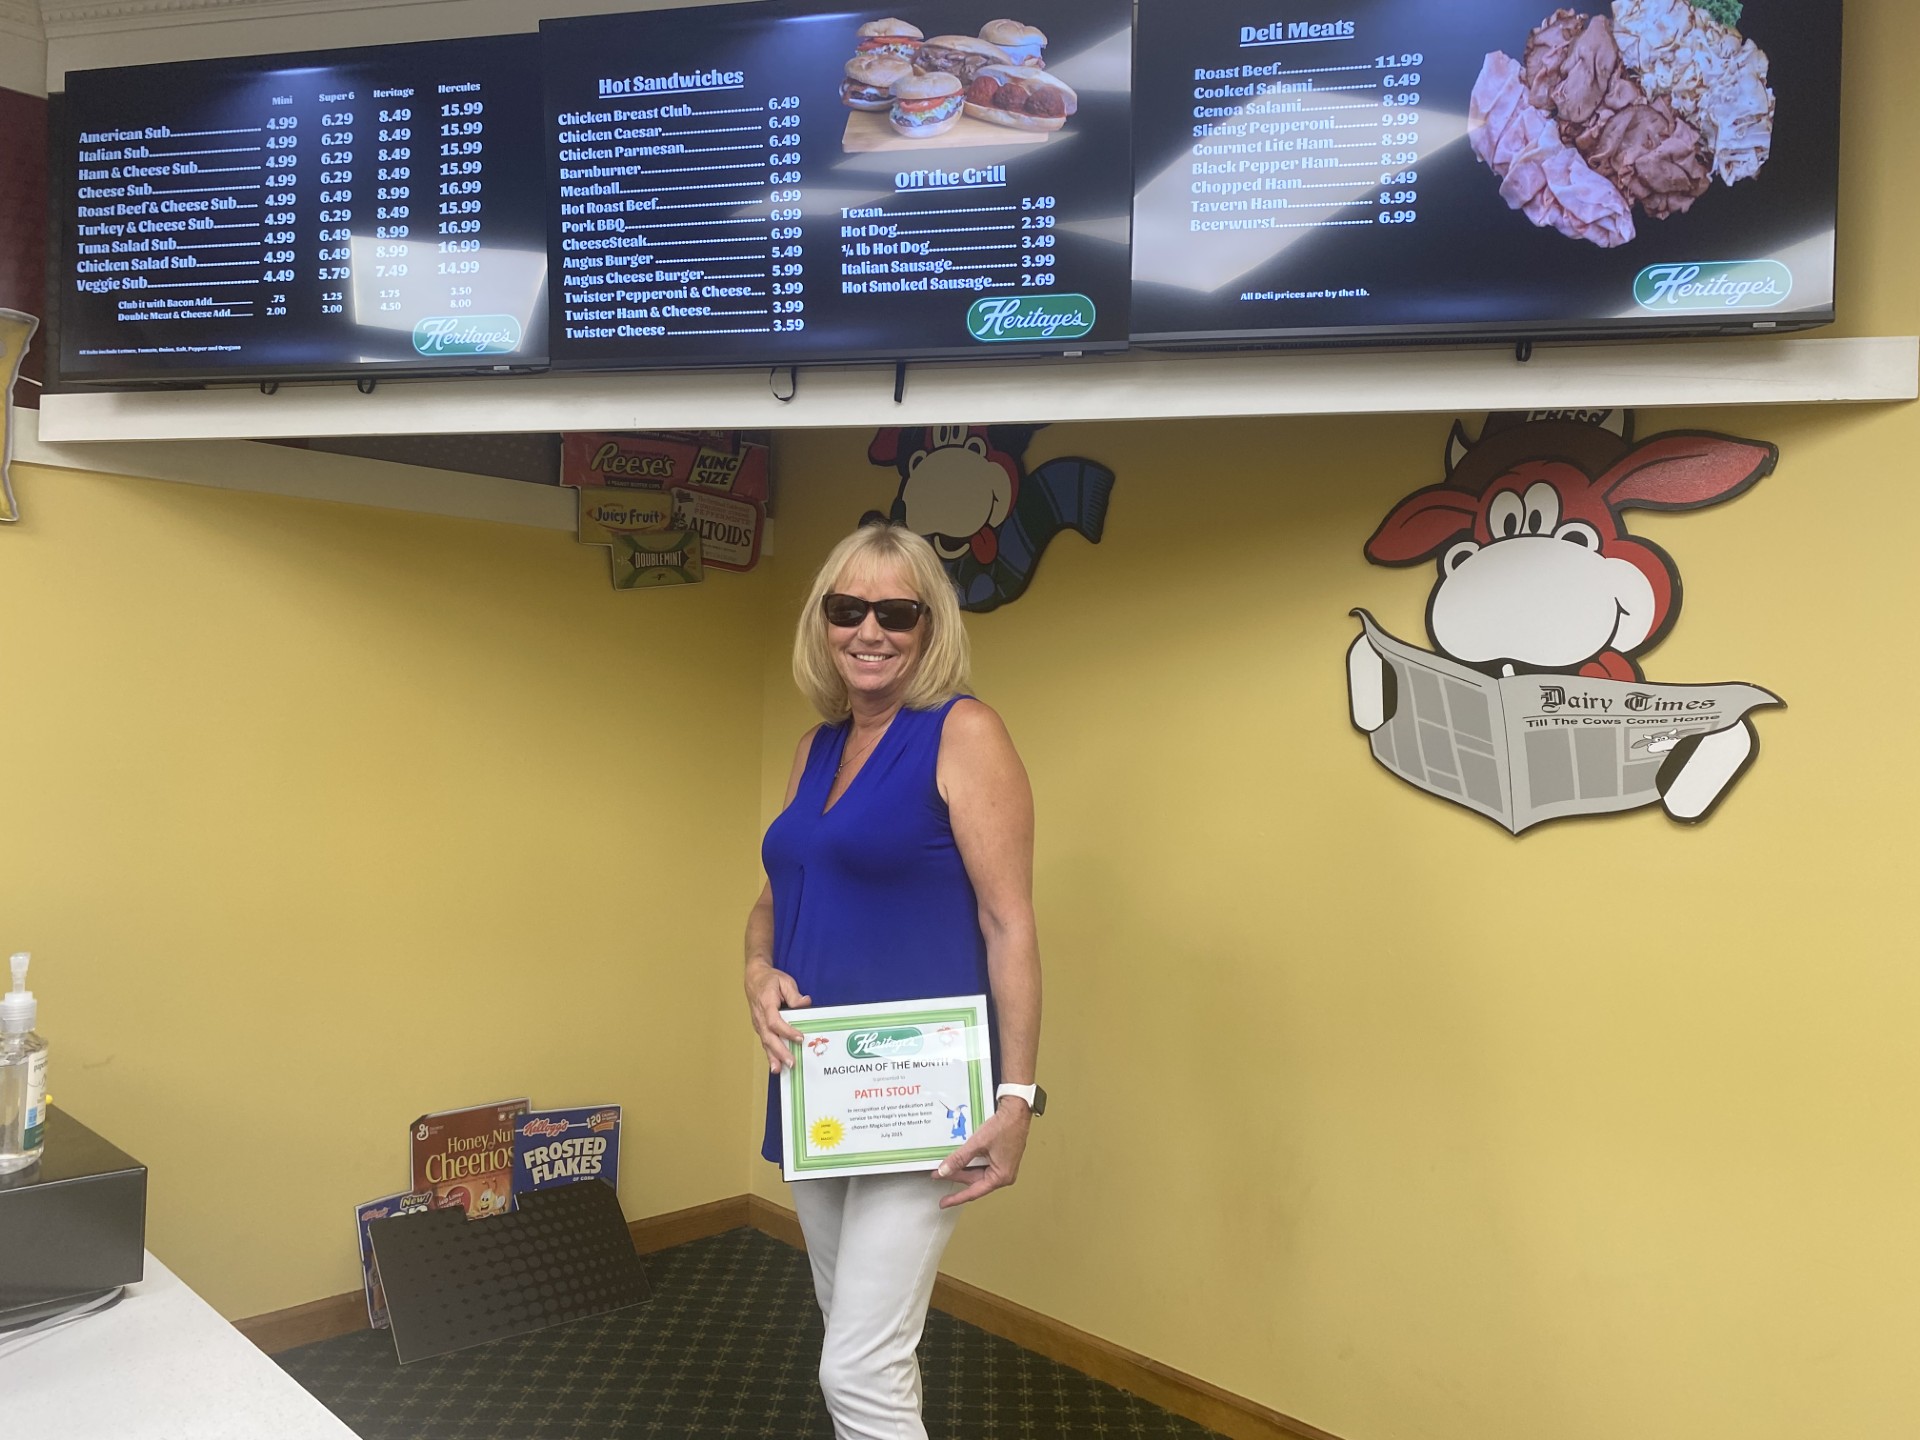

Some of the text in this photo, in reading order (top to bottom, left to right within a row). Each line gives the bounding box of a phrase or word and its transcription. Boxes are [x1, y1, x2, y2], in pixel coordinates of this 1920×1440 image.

[1241, 20, 1354, 43] Deli Meats
[1195, 53, 1423, 80] Roast Beef 11.99
[272, 82, 481, 105] Mini Super 6 Heritage Hercules
[599, 70, 744, 95] Hot Sandwiches
[1194, 73, 1420, 99] Cooked Salami 6.49
[558, 96, 800, 126] Chicken Breast Club 6.49
[1194, 93, 1420, 118] Genoa Salami 8.99
[79, 101, 483, 144] American Sub 4.99 6.29 8.49 15.99
[1193, 113, 1419, 138] Slicing Pepperoni 9.99
[1193, 132, 1418, 155] Gourmet Lite Ham 8.99
[560, 153, 800, 180] Barnburner 6.49
[1192, 152, 1417, 175] Black Pepper Ham 8.99
[895, 165, 1006, 188] Off the Grill
[1192, 171, 1417, 195] Chopped Ham 6.49
[841, 196, 1055, 219] Texan 5.49
[1191, 191, 1417, 212] Tavern Ham 8.99
[562, 209, 802, 233] Pork BBQ 6.99
[841, 216, 1055, 238] Hot Dog 2.39
[1191, 211, 1416, 231] Beerwurst 6.99
[562, 227, 802, 251] CheeseSteak 6.99
[856, 244, 870, 255] lb
[873, 243, 898, 255] Hot
[900, 241, 930, 255] Dog
[1022, 235, 1055, 248] 3.49
[118, 285, 471, 309] Club it with Bacon Add .75 1.25 1.75 3.50
[564, 283, 803, 304] Twister Pepperoni & Cheese 3.99
[1241, 292, 1254, 300] All
[1255, 292, 1273, 300] Deli
[1275, 291, 1305, 300] prices
[1306, 291, 1324, 299] are
[1325, 290, 1337, 300] by
[1338, 289, 1354, 297] the
[1644, 266, 1783, 305] Heritage's
[976, 299, 1088, 336] Heritage's
[420, 318, 515, 351] Heritage's
[590, 442, 675, 477] Reese's
[698, 454, 738, 471] KING
[696, 471, 730, 485] SIZE
[595, 507, 659, 523] Juicy Fruit
[688, 517, 752, 546] ALTOIDS
[635, 551, 682, 568] DOUBLEMINT
[1539, 685, 1716, 713] Dairy Times
[1526, 719, 1548, 727] Till
[1583, 717, 1621, 725] Cows
[1626, 717, 1668, 725] Come
[824, 1064, 872, 1075] MAGICIAN
[875, 1063, 888, 1071] OF
[891, 1061, 910, 1070] THE
[855, 1085, 921, 1099] PATTI STOUT
[523, 1118, 569, 1137] Kellogg's
[587, 1114, 601, 1128] 120
[448, 1129, 515, 1154] Honey Nut
[524, 1137, 607, 1169] FROSTED
[426, 1146, 515, 1184] Cheerios
[532, 1156, 602, 1184] FLAKES
